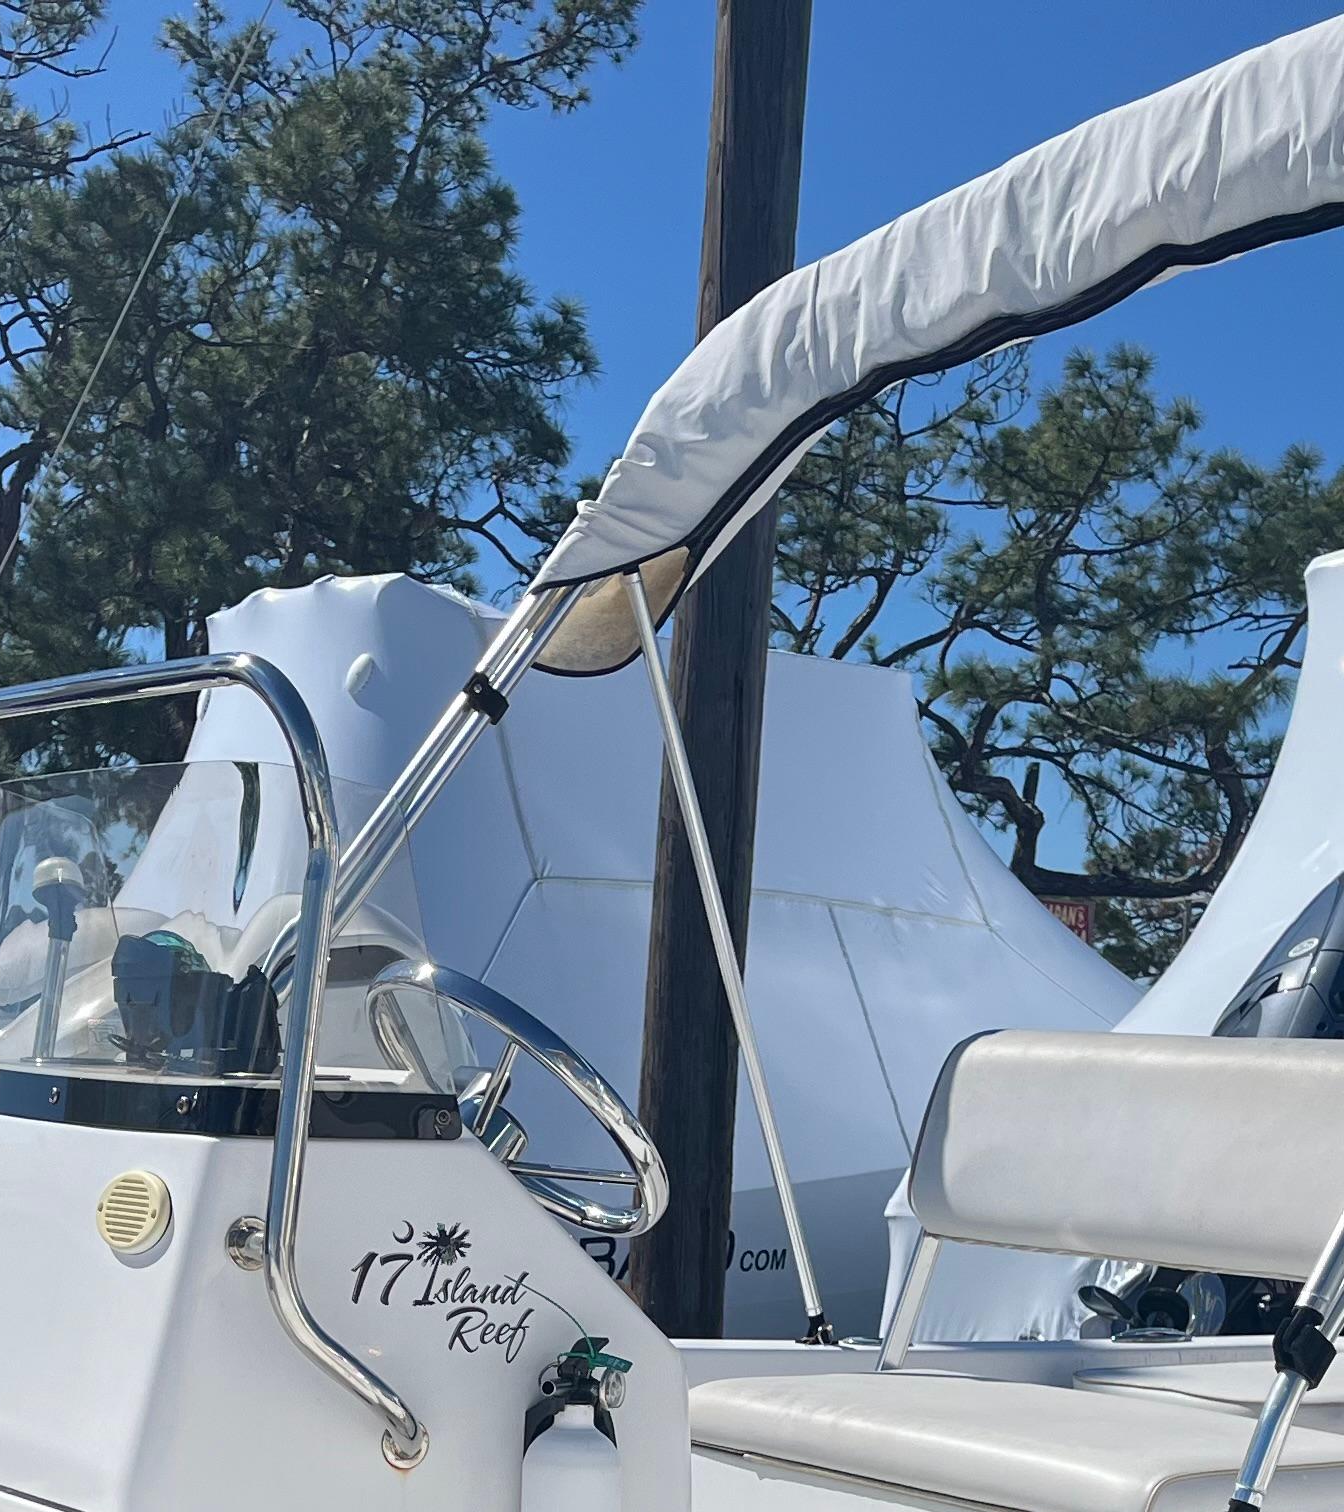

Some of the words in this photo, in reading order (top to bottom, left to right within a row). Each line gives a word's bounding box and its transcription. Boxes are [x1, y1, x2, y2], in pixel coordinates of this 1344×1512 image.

[351, 1251, 414, 1305] 17
[413, 1245, 529, 1306] Island
[446, 1306, 535, 1363] Reef
